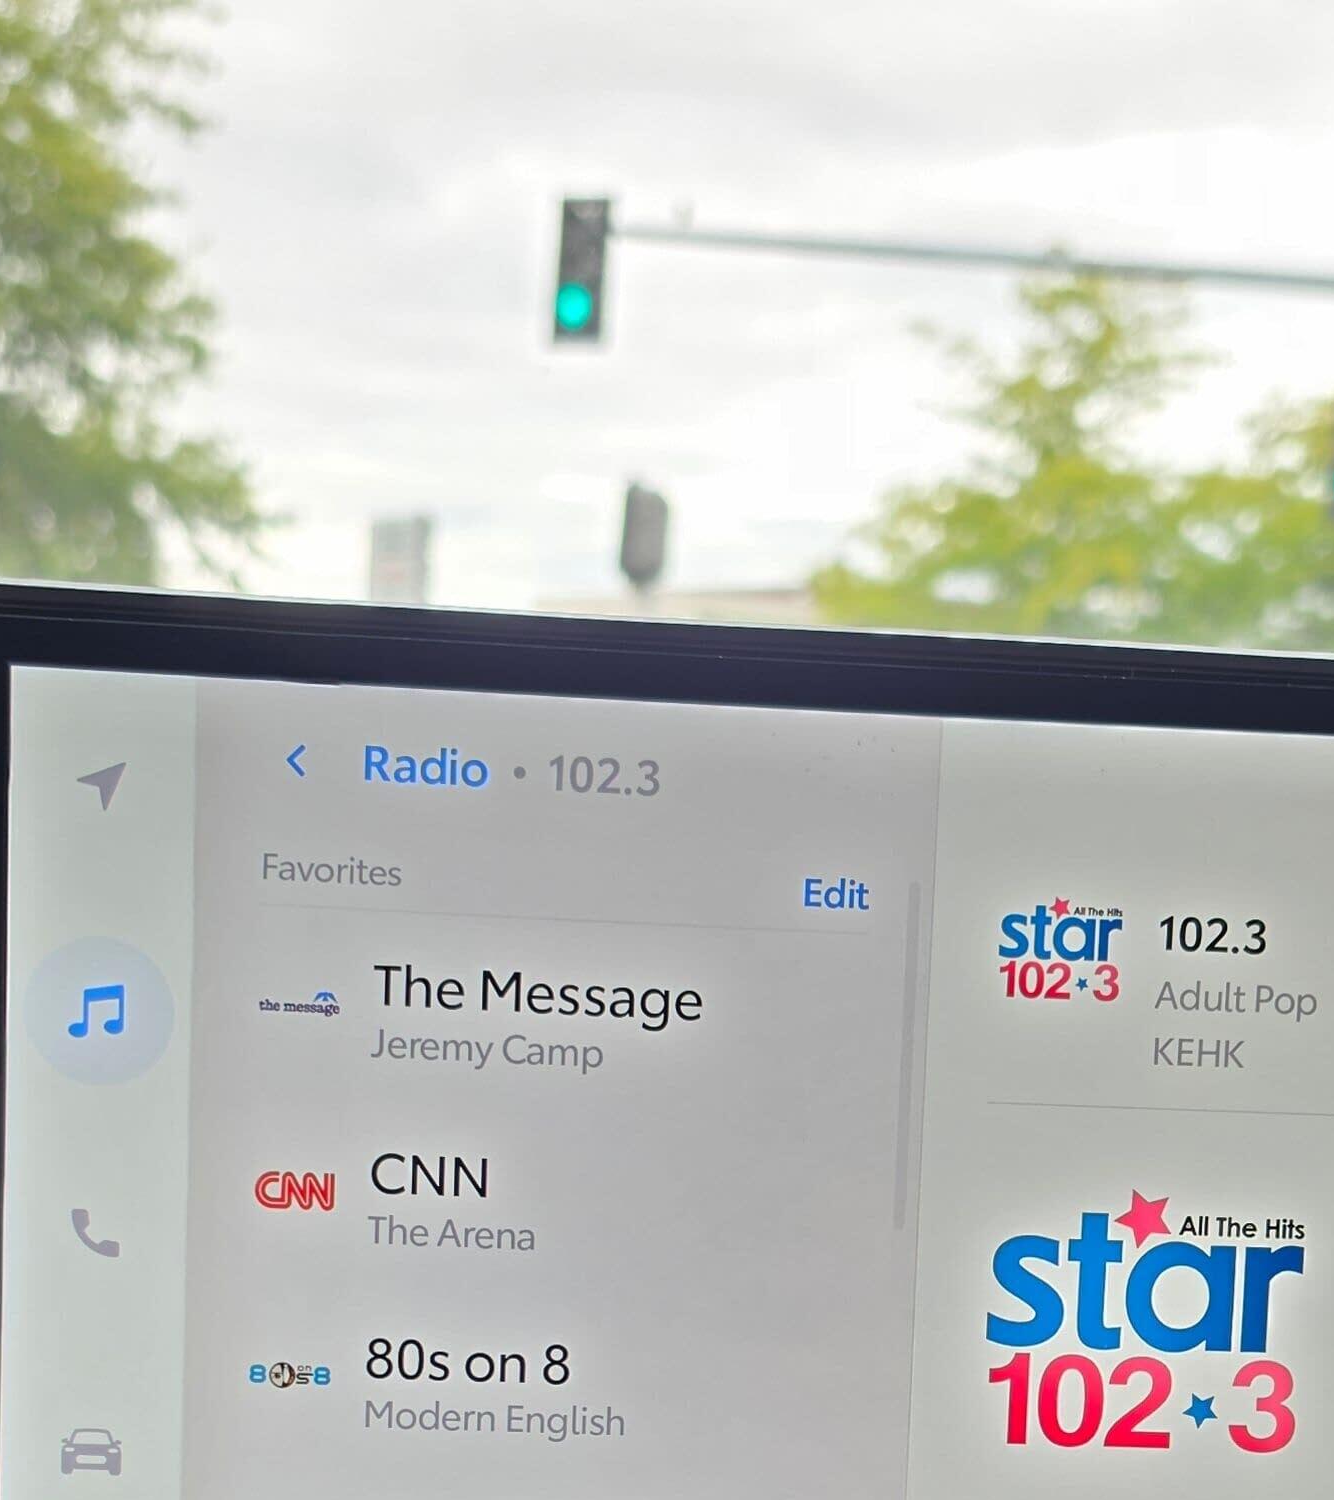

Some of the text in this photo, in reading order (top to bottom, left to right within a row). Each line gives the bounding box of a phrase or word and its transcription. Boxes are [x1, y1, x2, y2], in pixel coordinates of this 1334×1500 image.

[364, 745, 660, 797] Radio 102.3
[262, 853, 402, 887] Favorites
[803, 879, 869, 911] Edit
[1073, 906, 1086, 917] All
[1088, 907, 1105, 918] The
[999, 905, 1123, 962] star
[1160, 915, 1267, 956] 102.3
[259, 999, 340, 1018] the message
[374, 964, 703, 1032] The Message
[1154, 980, 1318, 1023] Adult Pop
[371, 1029, 604, 1075] Jeremy Camp
[1153, 1037, 1245, 1069] KEHK
[255, 1171, 337, 1212] CNN
[370, 1153, 488, 1199] CNN
[368, 1216, 535, 1251] The Arena
[1179, 1215, 1305, 1240] All The Hits
[986, 1212, 1304, 1354] star
[366, 1337, 571, 1386] 80s on 8
[364, 1401, 626, 1442] Modern English
